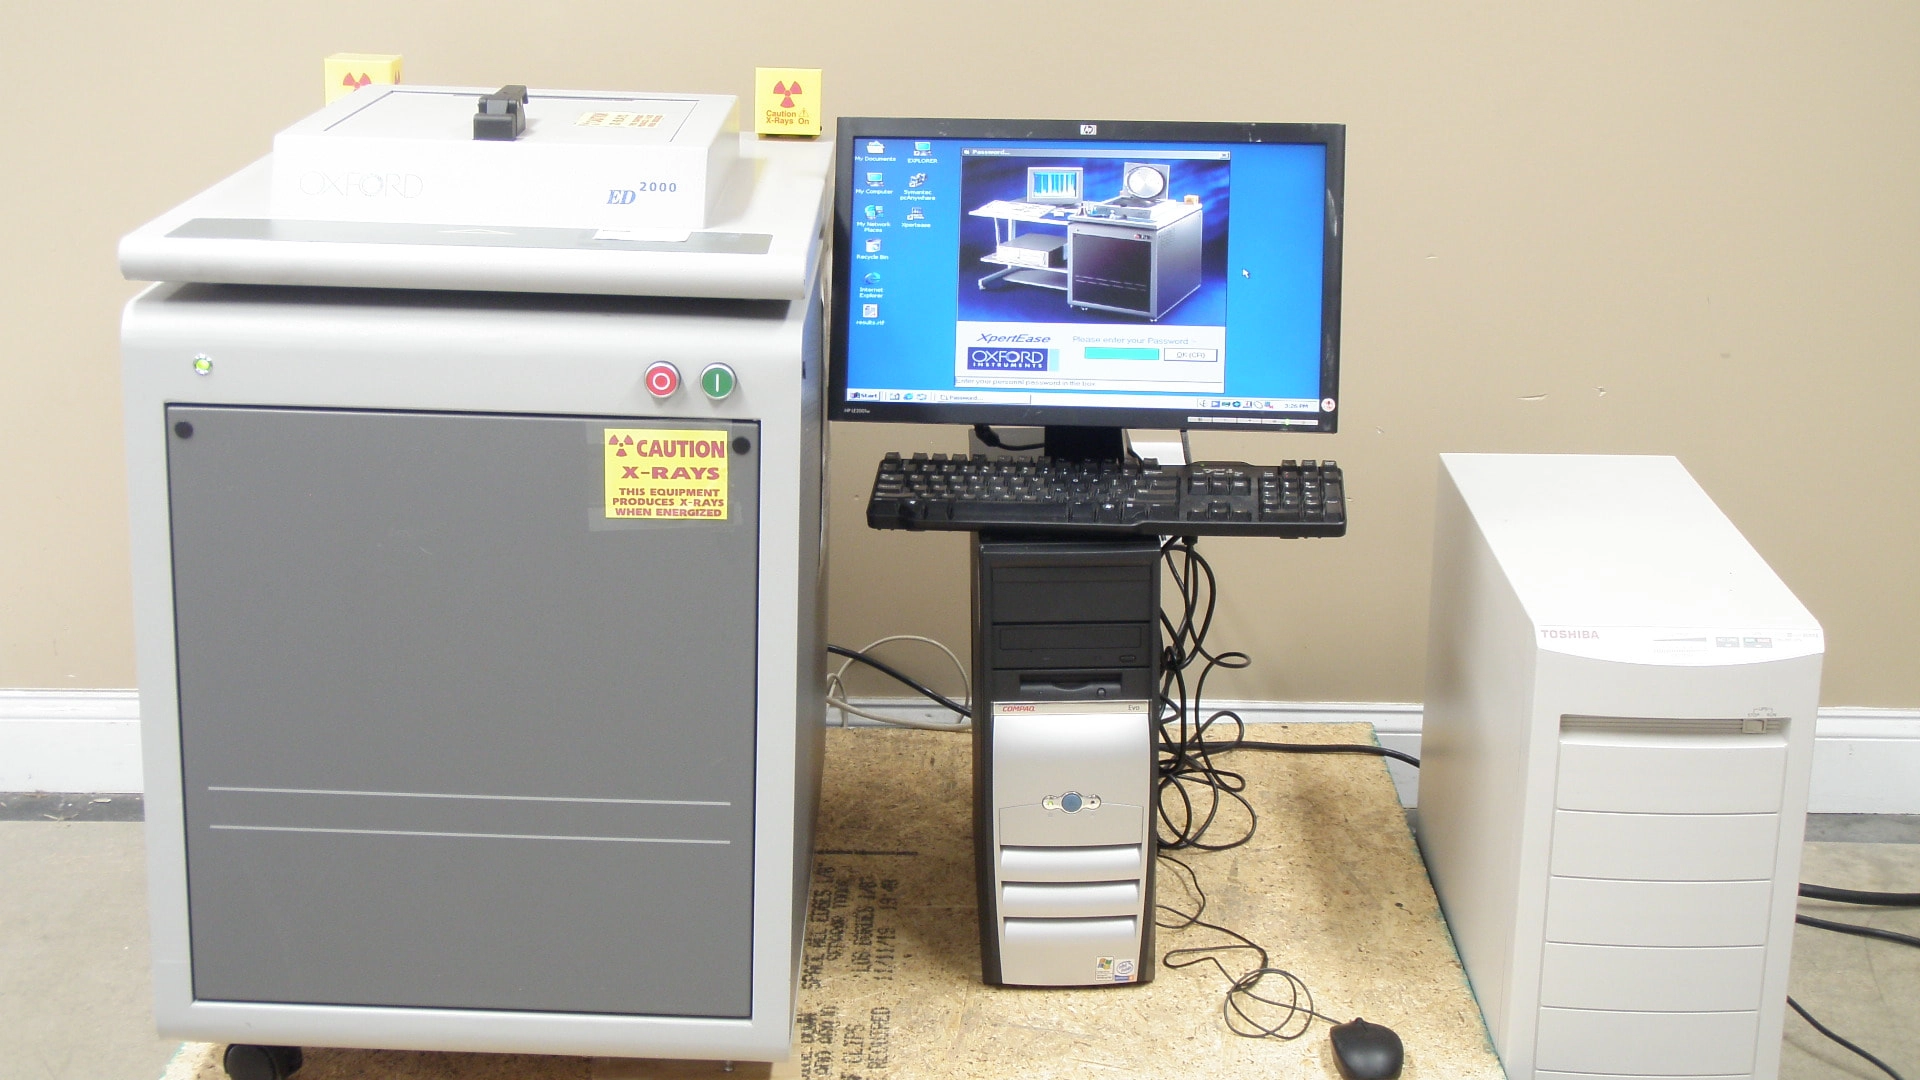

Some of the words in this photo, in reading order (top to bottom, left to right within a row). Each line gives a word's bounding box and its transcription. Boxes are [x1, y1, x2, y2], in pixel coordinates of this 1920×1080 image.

[766, 109, 797, 118] Caution
[766, 117, 794, 125] X-Rays
[798, 117, 810, 125] On
[299, 170, 424, 199] OXFORD
[606, 189, 637, 205] ED
[639, 181, 677, 193] 2000
[976, 333, 1051, 344] XpertEase
[1072, 335, 1101, 343] Please
[1103, 336, 1125, 344] enter
[1147, 337, 1189, 345] Password
[971, 350, 1044, 363] OXFORD
[636, 439, 726, 459] CAUTION
[620, 466, 720, 480] X-RAYS
[618, 487, 646, 496] THIS
[649, 488, 721, 497] EQUIPMENT
[612, 498, 675, 506] PRODUCES
[679, 498, 725, 507] X-RAYS
[615, 508, 652, 516] WHEN
[656, 509, 722, 517] ENERGIZED
[1540, 629, 1600, 640] TOSHIBA
[841, 1024, 865, 1064] CLIPS
